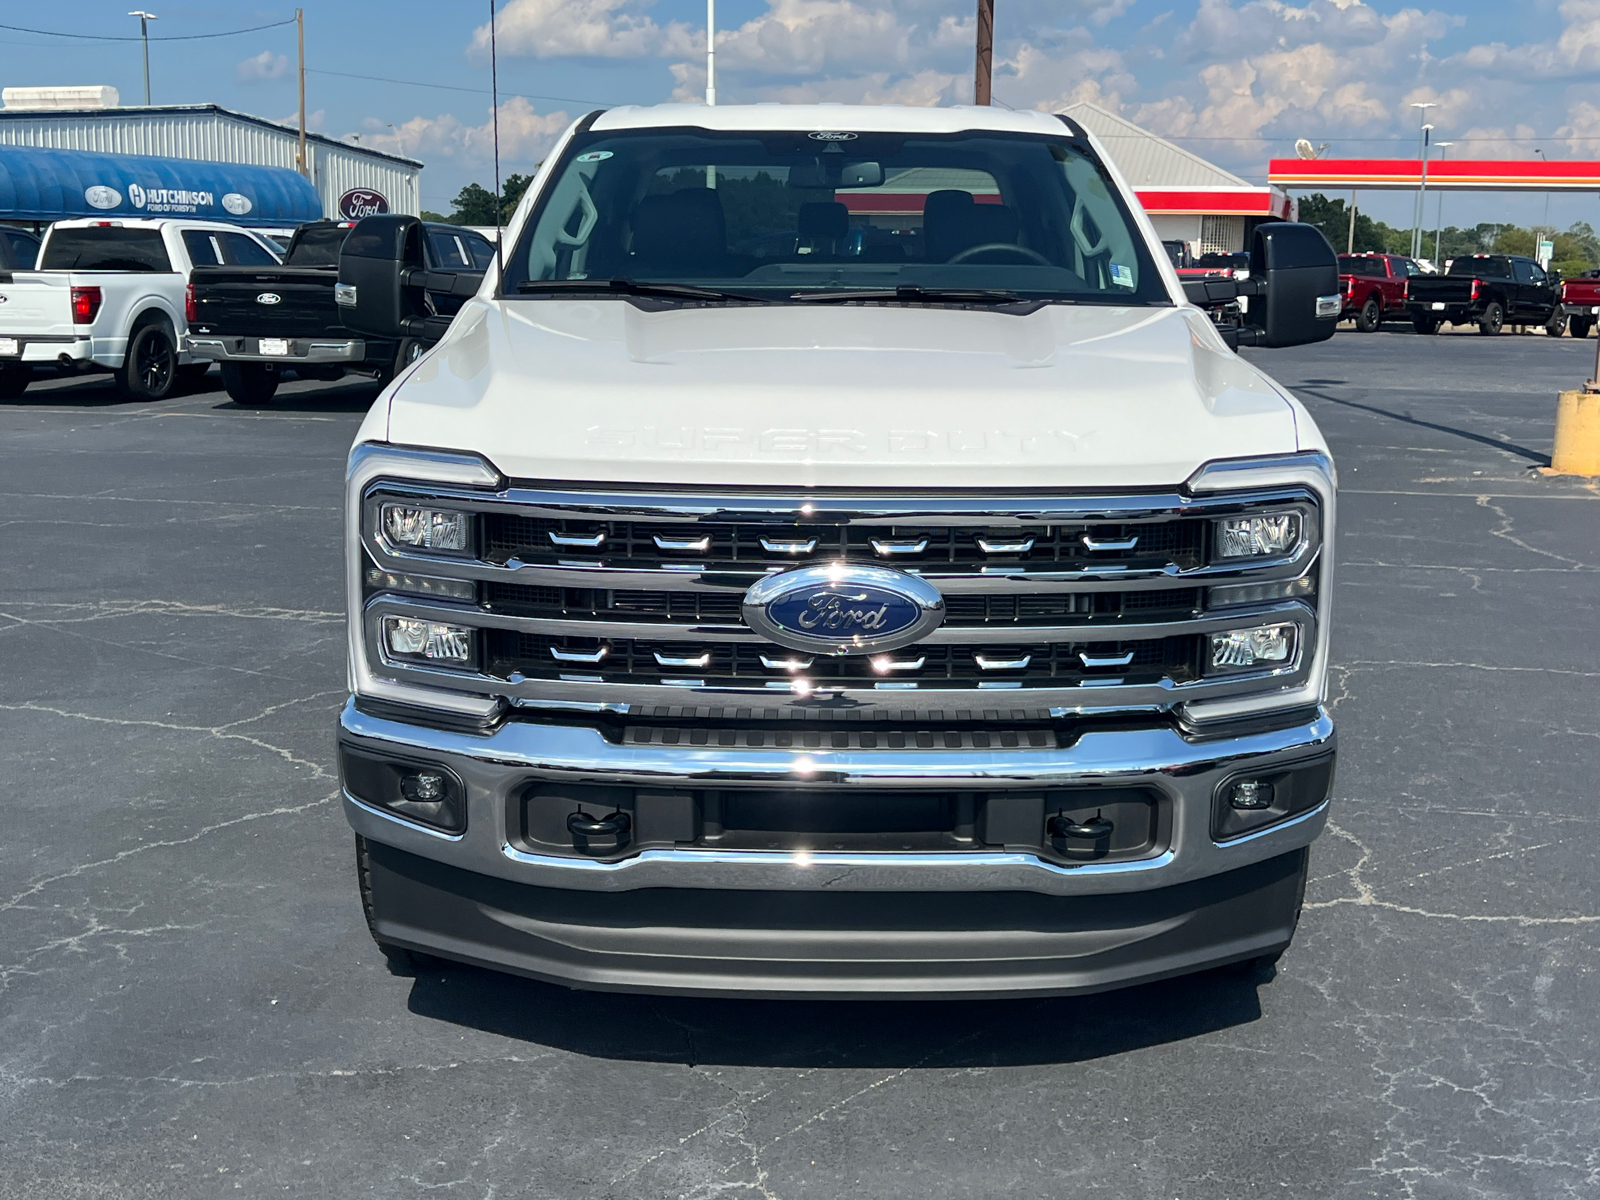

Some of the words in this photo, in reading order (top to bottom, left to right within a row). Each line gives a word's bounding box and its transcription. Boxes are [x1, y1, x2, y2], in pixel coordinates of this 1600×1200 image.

[817, 131, 849, 140] Ford
[146, 188, 214, 206] HUTCHINSON
[349, 193, 380, 217] Ford
[147, 203, 162, 212] FORD
[163, 204, 171, 212] OF
[171, 205, 197, 213] FORSYTH
[584, 425, 867, 453] SUPER
[888, 428, 1100, 453] DUTY
[798, 592, 890, 630] Ford
